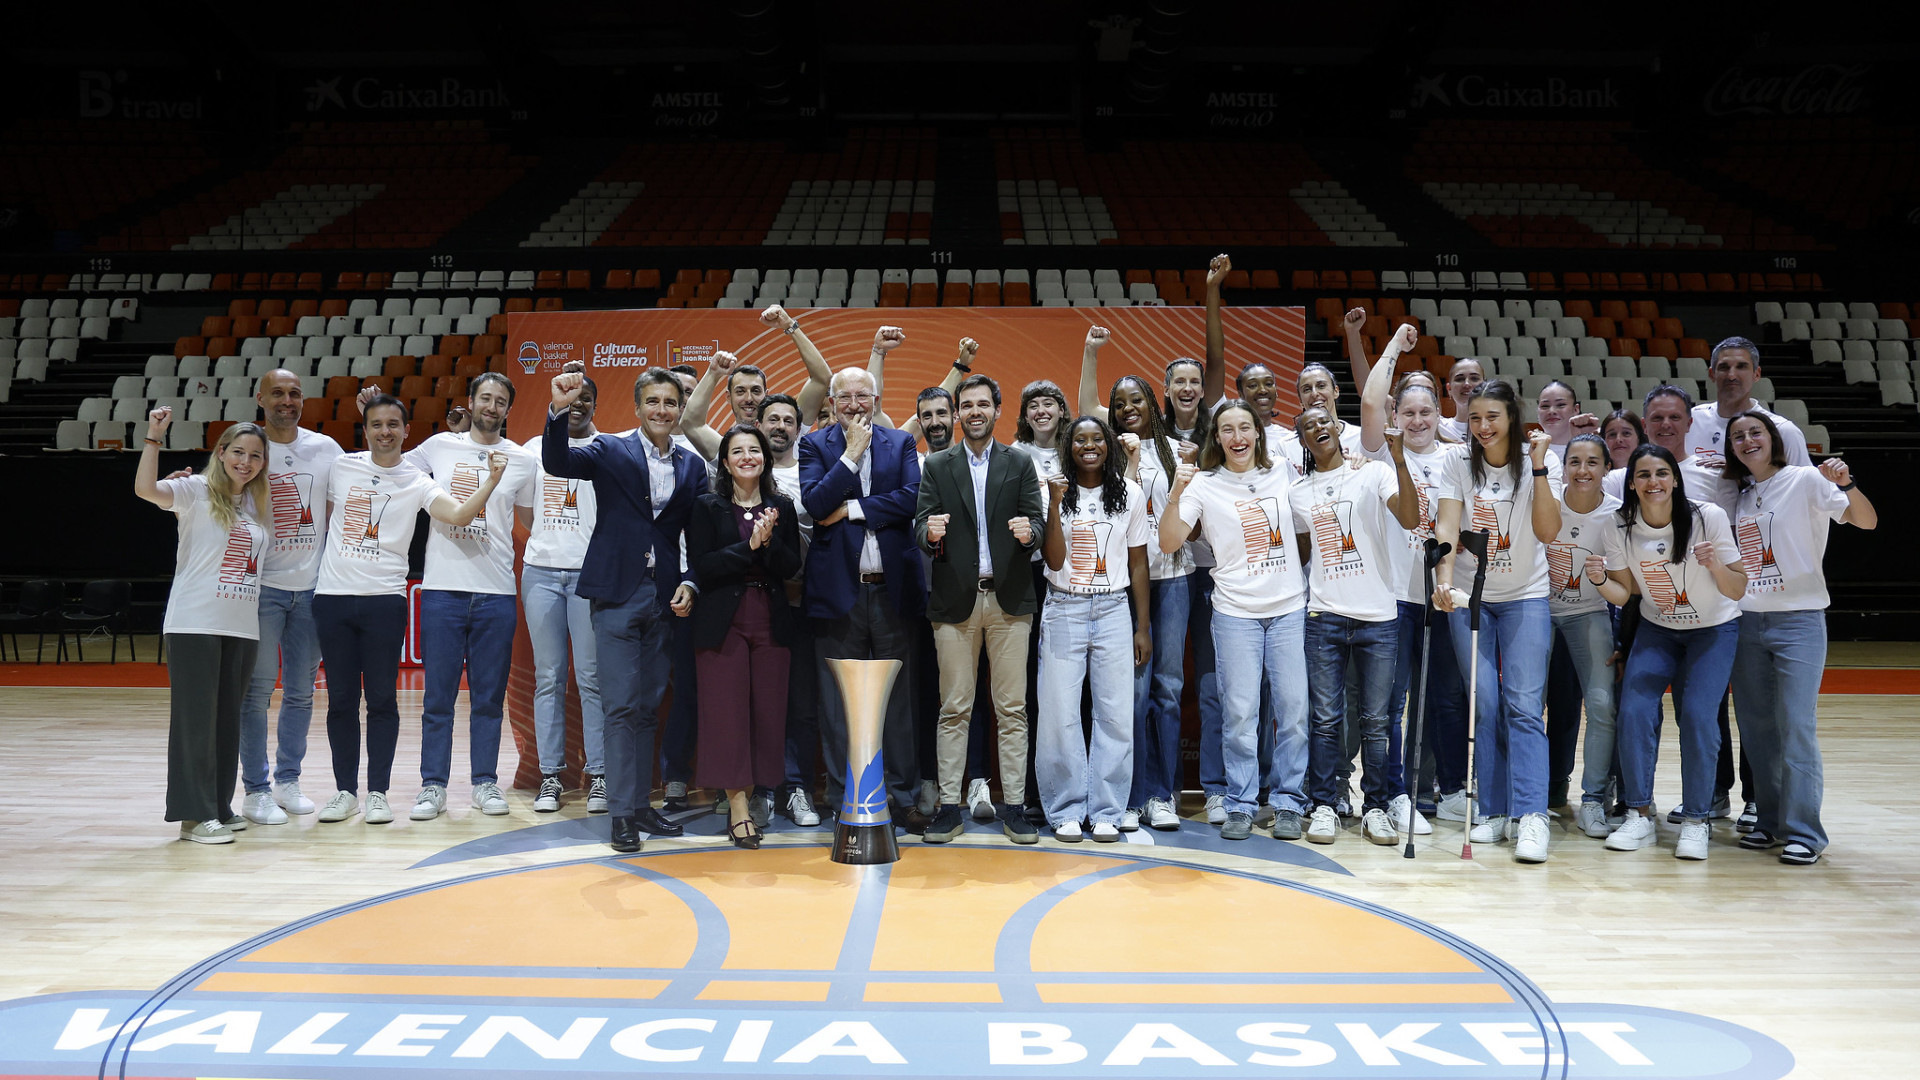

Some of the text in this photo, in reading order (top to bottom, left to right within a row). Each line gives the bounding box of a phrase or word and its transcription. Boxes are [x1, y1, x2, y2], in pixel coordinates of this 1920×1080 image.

[352, 77, 510, 109] CaixaBank
[1456, 75, 1619, 108] CaixaBank
[652, 92, 723, 107] AMSTEL
[1206, 93, 1278, 107] AMSTEL
[121, 97, 202, 119] travel
[89, 258, 112, 271] 113
[430, 255, 454, 268] 112
[930, 251, 953, 265] 111
[1435, 254, 1459, 266] 110
[1773, 257, 1797, 269] 109
[543, 341, 574, 350] valencia
[593, 342, 636, 355] Cultura
[543, 351, 568, 360] basket
[592, 354, 648, 367] Esfuerzo
[543, 360, 561, 369] club
[1335, 562, 1364, 572] ENDESA
[1753, 578, 1783, 587] ENDESA
[53, 1008, 1656, 1068] VALENCIA BASKET
